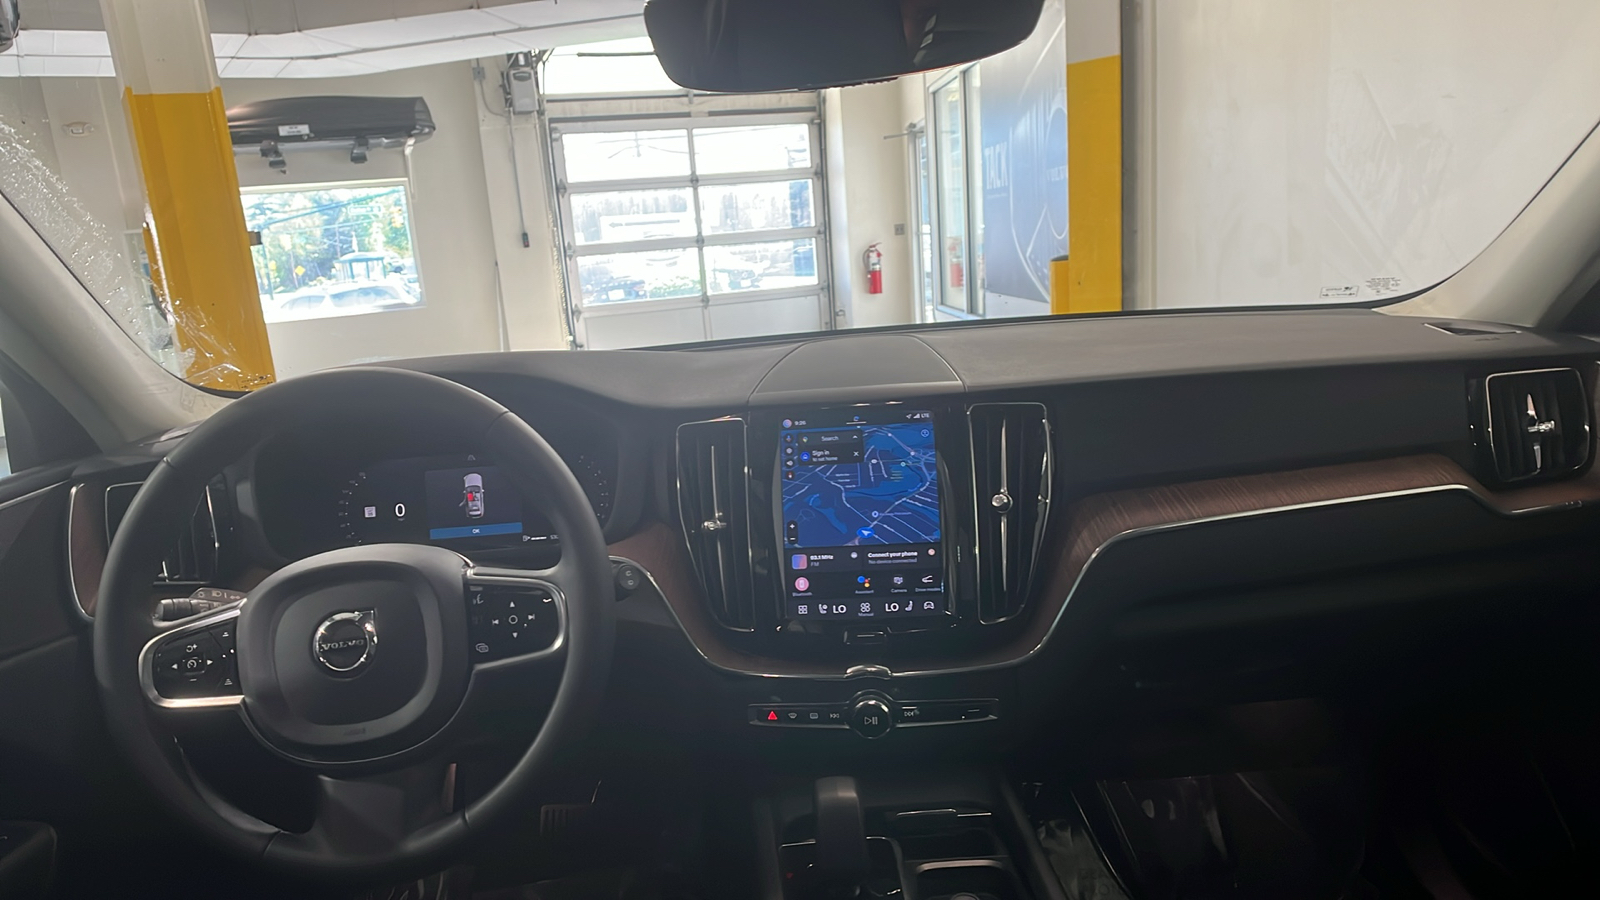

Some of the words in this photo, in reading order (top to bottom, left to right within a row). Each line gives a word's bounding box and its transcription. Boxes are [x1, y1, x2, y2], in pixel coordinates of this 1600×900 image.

[395, 503, 405, 517] 0
[832, 604, 847, 614] LO
[885, 602, 899, 612] LO
[321, 639, 364, 651] VOLVO
